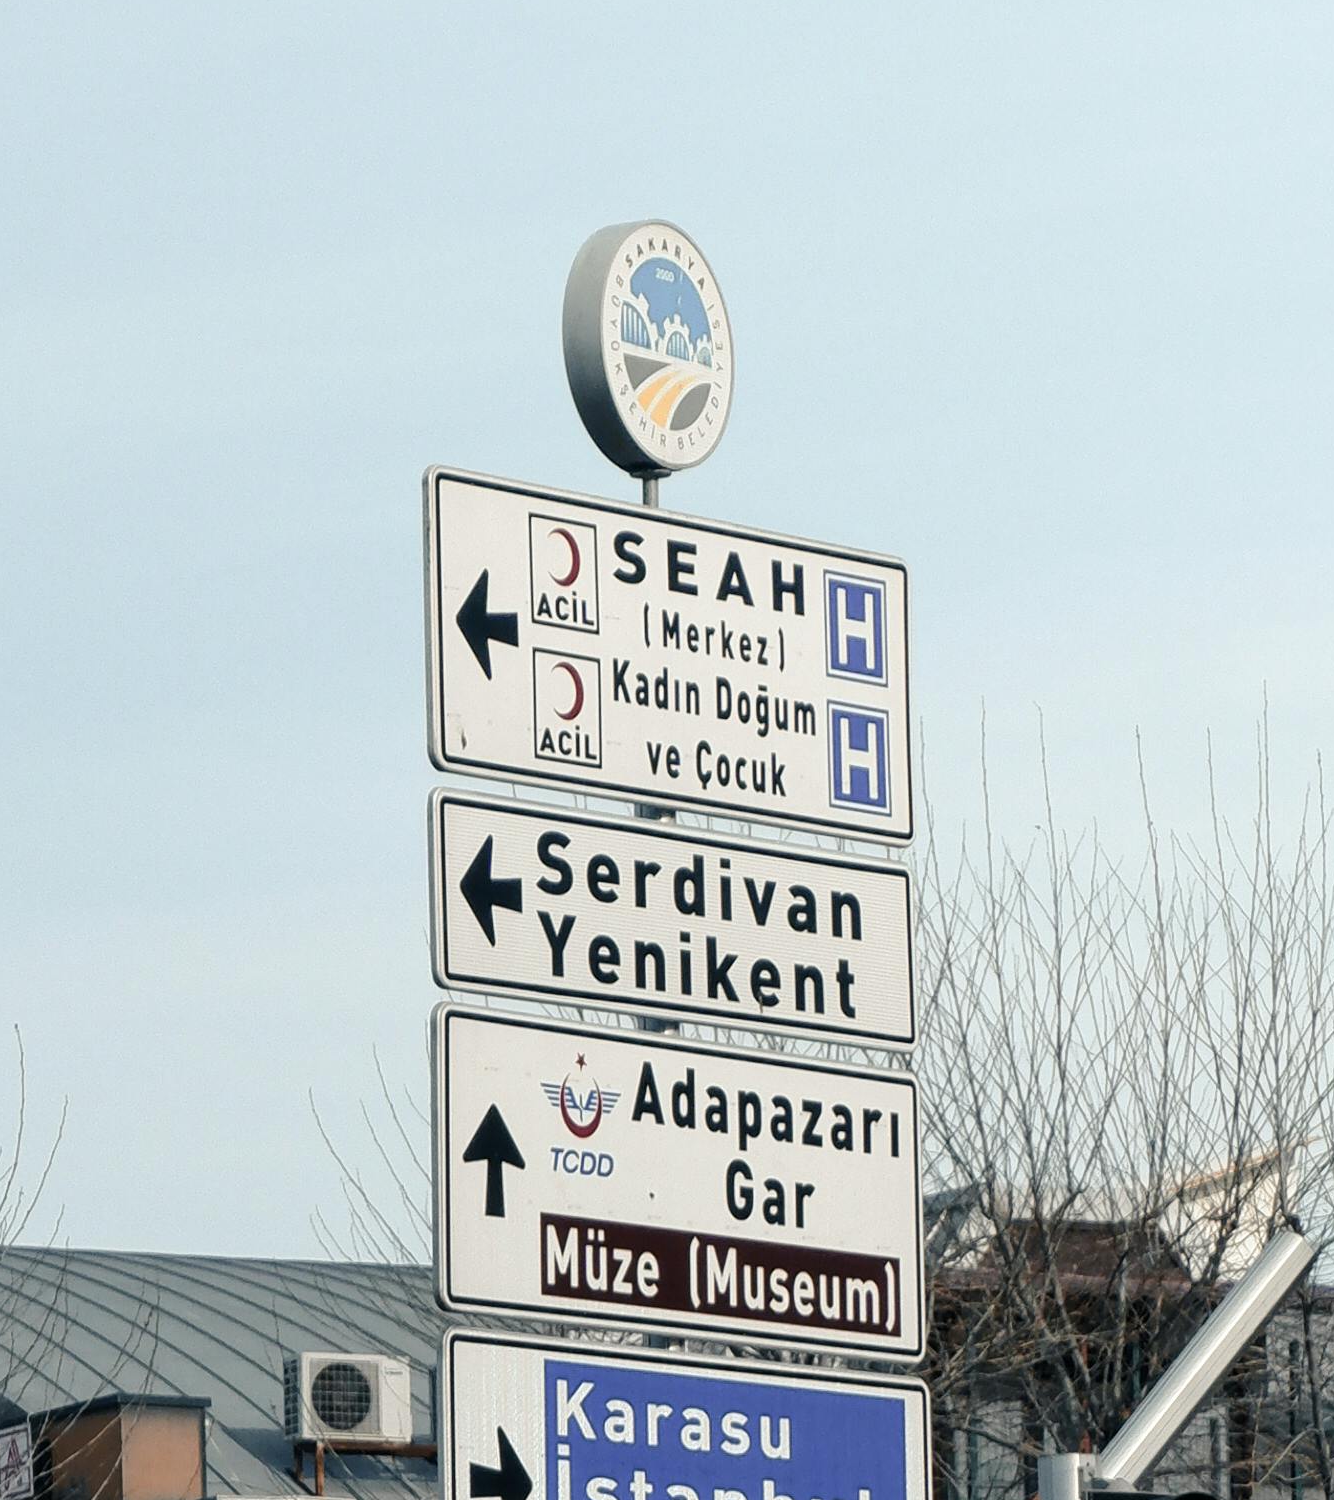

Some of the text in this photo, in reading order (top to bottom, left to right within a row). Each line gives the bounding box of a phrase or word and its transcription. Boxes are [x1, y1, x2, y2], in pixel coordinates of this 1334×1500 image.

[625, 237, 706, 291] SAKARYA
[536, 591, 595, 627] ACİL
[612, 531, 805, 616] SEAH
[612, 660, 817, 737] Kadın Doğum
[540, 726, 597, 761] ACİL
[646, 742, 786, 796] ve Çocuk
[536, 831, 862, 940] Serdivan
[537, 910, 856, 1018] Yenikent
[632, 1061, 900, 1157] Adapazarı
[550, 1147, 614, 1178] TCDD
[726, 1158, 815, 1229] Gar
[545, 1224, 896, 1331] Müze (Museum)
[557, 1380, 793, 1460] Karasu
